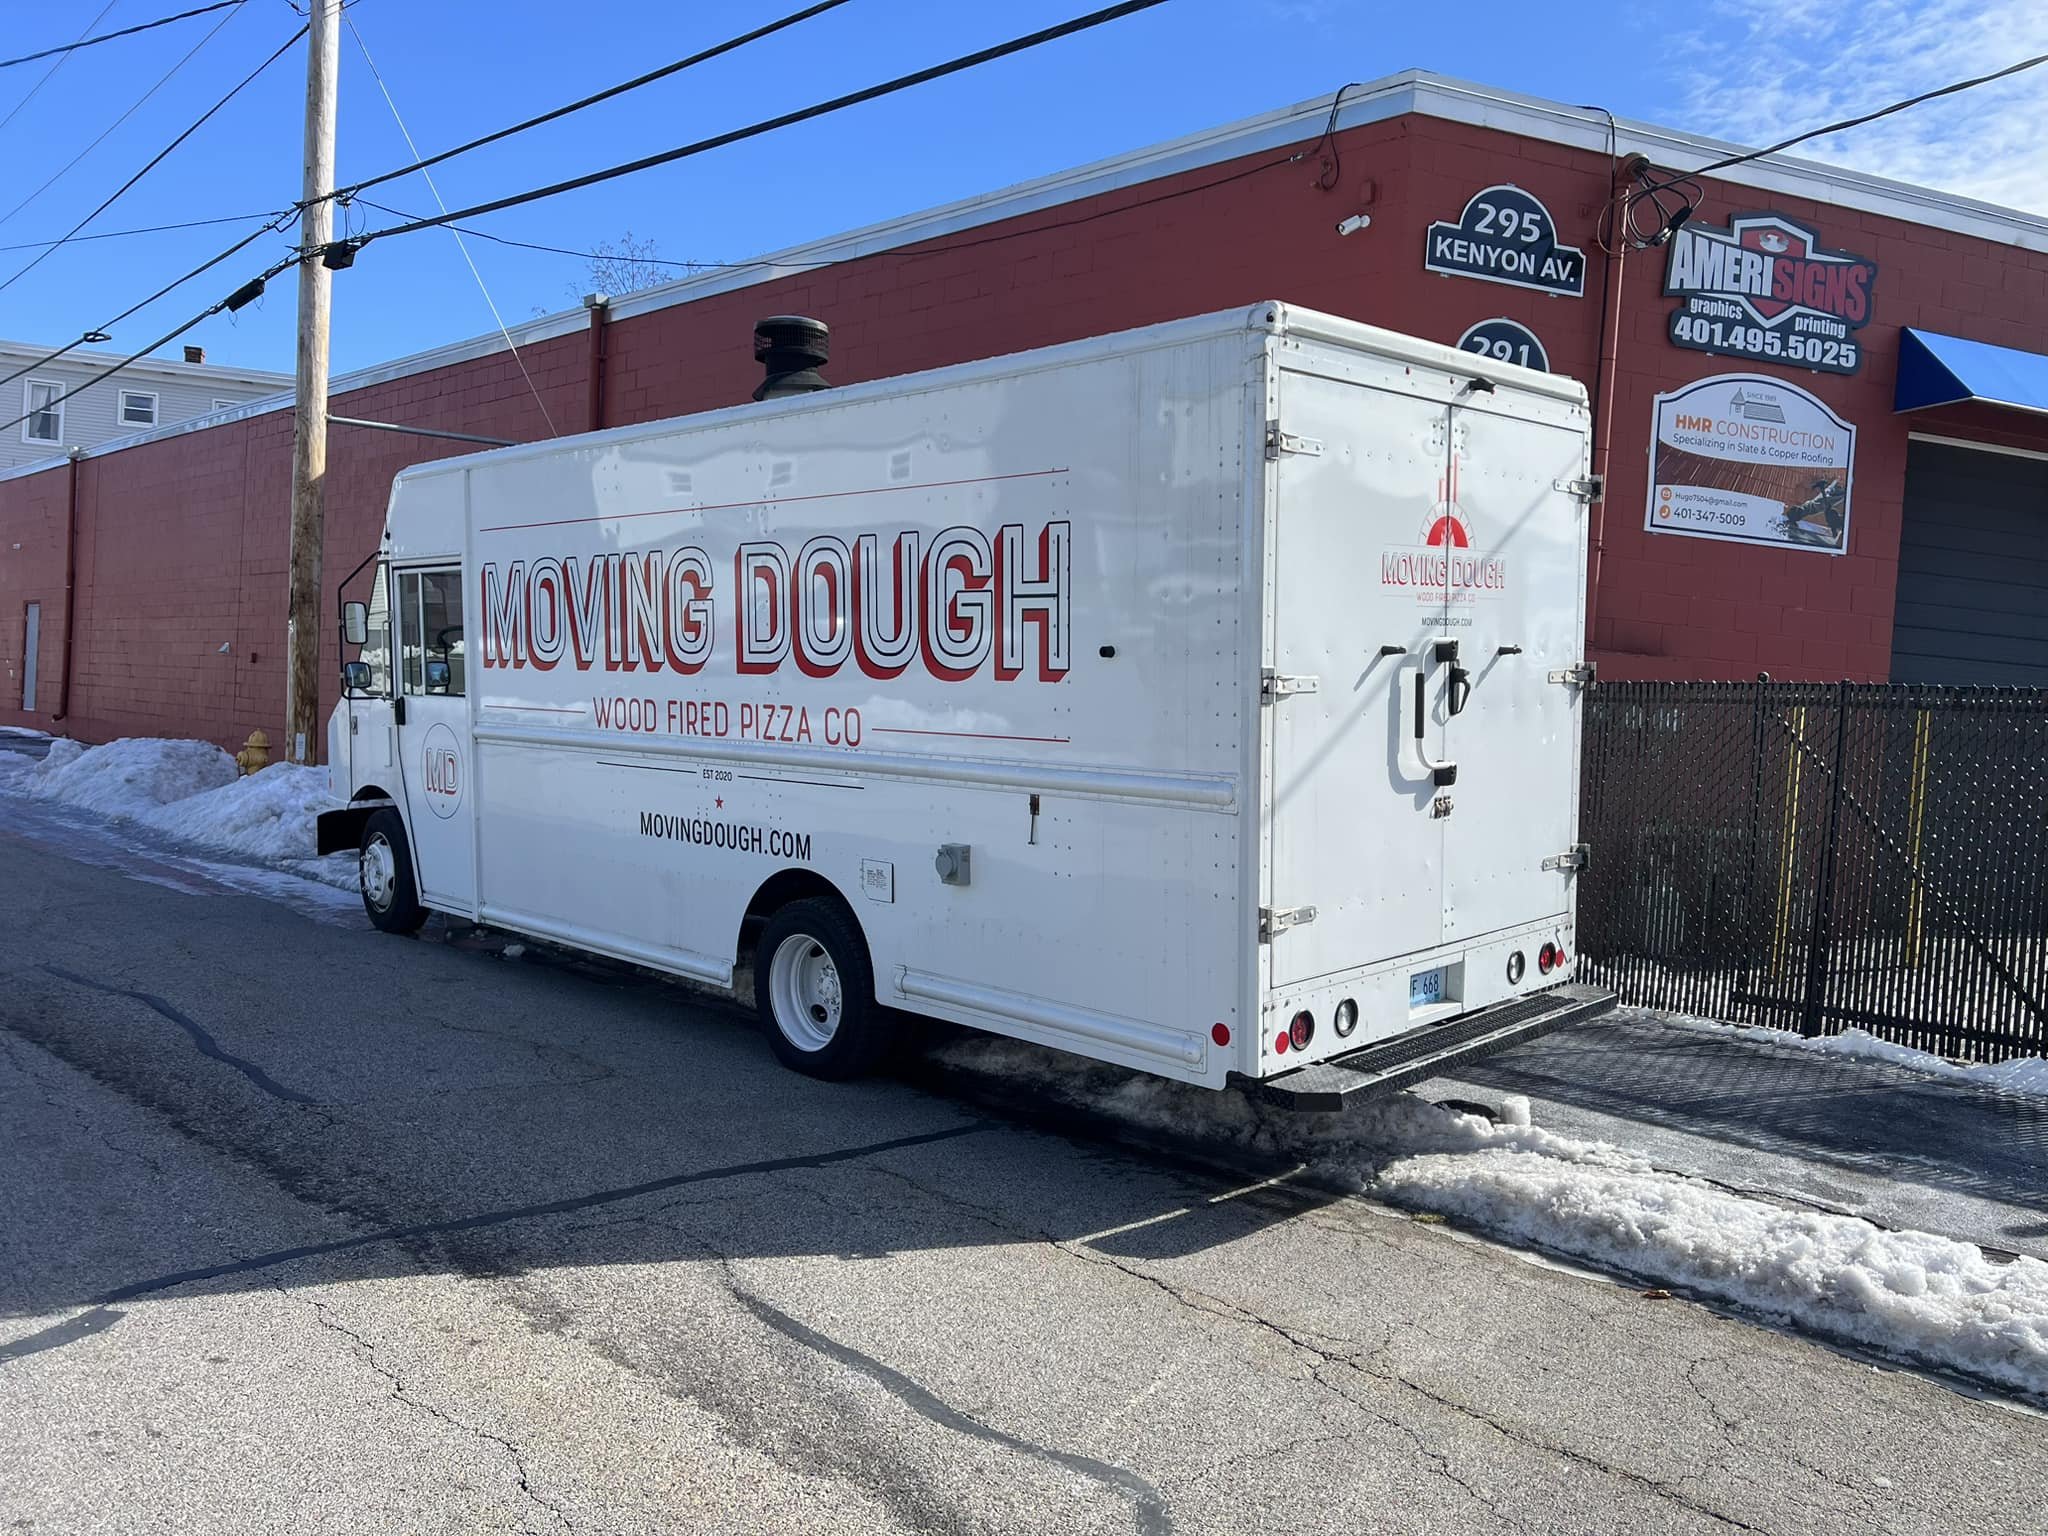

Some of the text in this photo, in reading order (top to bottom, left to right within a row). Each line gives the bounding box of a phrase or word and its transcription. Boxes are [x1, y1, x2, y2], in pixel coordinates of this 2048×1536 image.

[1474, 203, 1541, 243] 295
[1435, 236, 1575, 282] KENYON AV.
[1669, 228, 1868, 322] AMERISIGNS
[1690, 298, 1846, 339] graphics printing
[1473, 336, 1530, 368] 291
[1674, 316, 1857, 368] 401.495.5025
[1672, 433, 1726, 451] Specializing
[1727, 440, 1736, 450] in
[1738, 442, 1759, 455] Slate
[1768, 447, 1799, 460] Copper
[1801, 452, 1834, 466] Roofing
[1675, 414, 1835, 451] HMR CONSTRUCTION
[1673, 507, 1746, 526] 401-347-5009
[1381, 552, 1505, 589] MOVING DOUGH
[482, 520, 1071, 683] MOVING DOUGH
[1421, 616, 1473, 627] MOVINGDOUGH.COM
[593, 697, 862, 747] WOOD FIRED PIZZA CO
[425, 747, 457, 795] MD
[702, 768, 733, 782] EST 2020
[640, 811, 811, 861] MOVINGDOUGH.COM
[1423, 974, 1439, 995] 668
